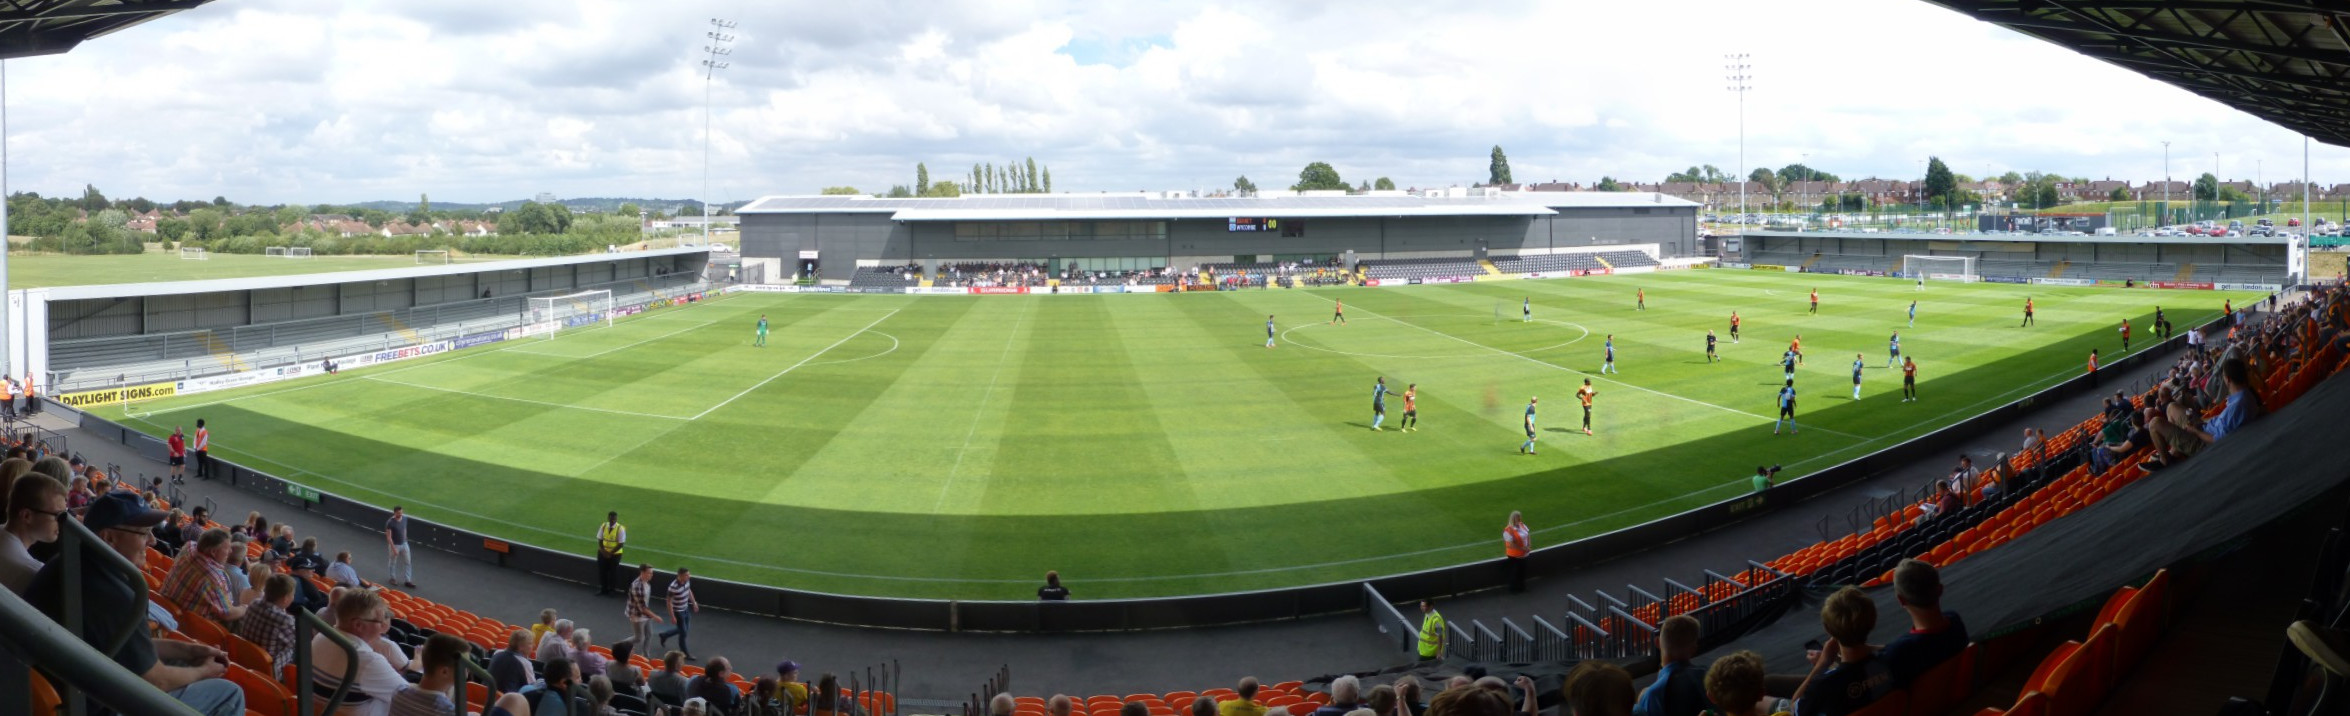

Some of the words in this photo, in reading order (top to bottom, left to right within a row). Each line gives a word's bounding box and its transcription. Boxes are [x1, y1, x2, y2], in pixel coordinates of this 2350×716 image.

[375, 342, 447, 363] FREEBETS.CO.UK
[63, 391, 118, 405] DAYLIGHT
[120, 386, 174, 400] SIGNS.com
